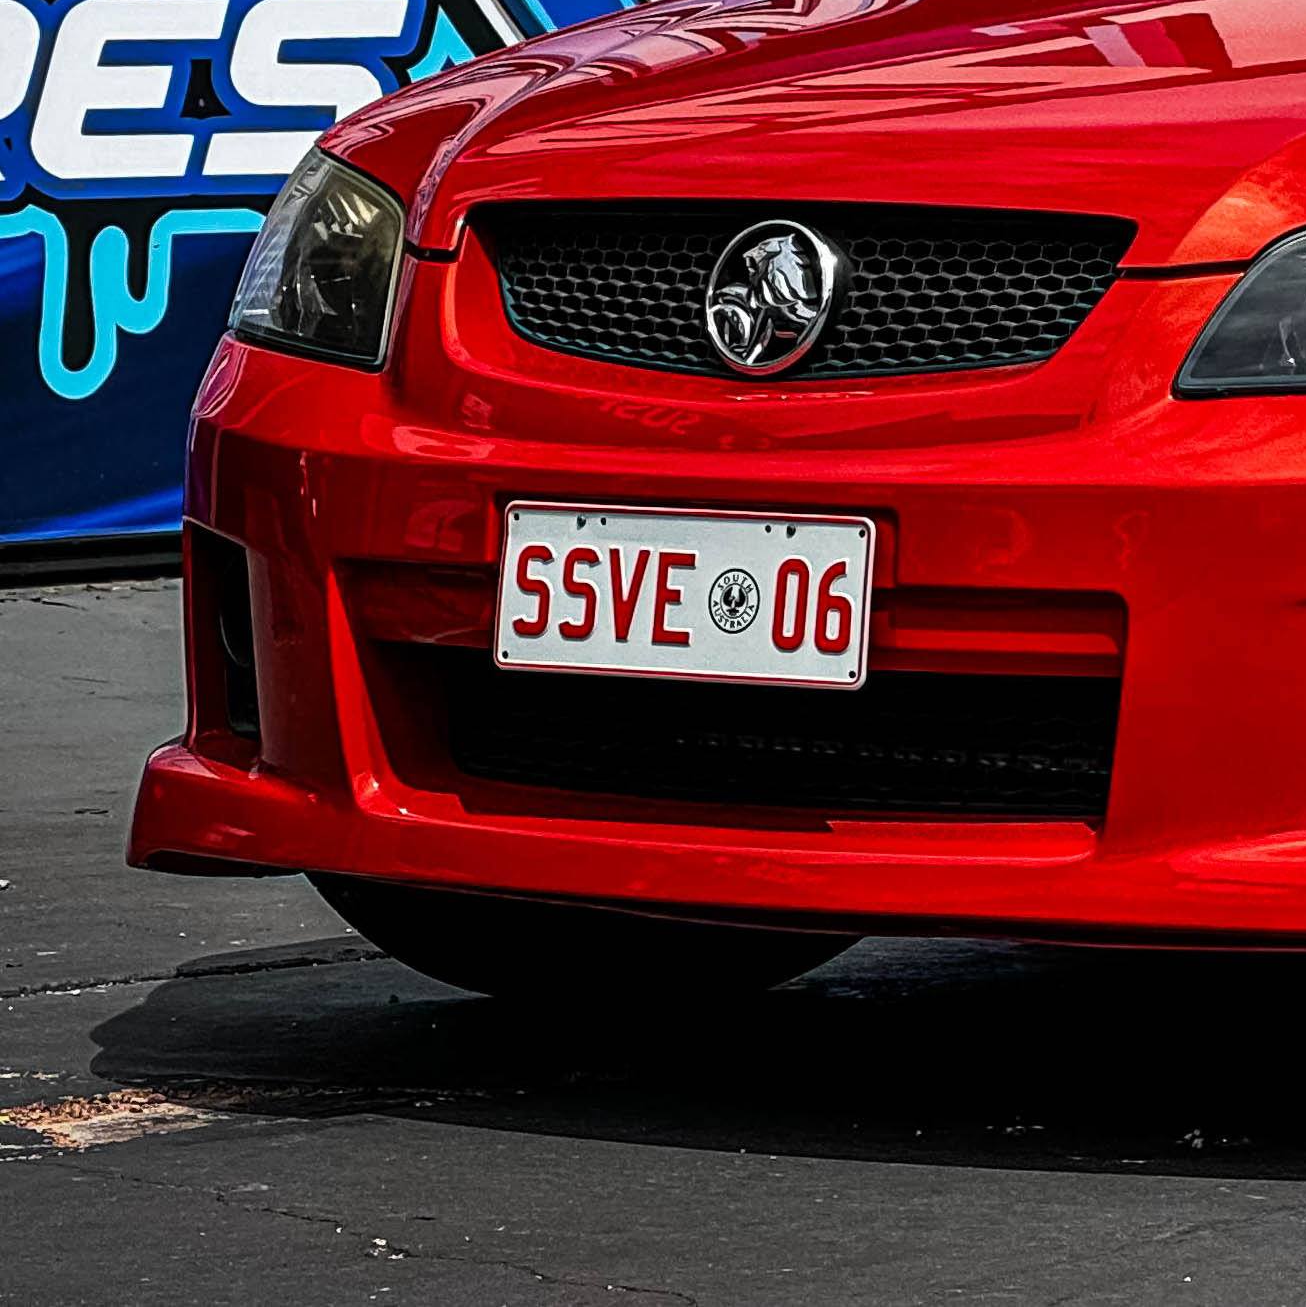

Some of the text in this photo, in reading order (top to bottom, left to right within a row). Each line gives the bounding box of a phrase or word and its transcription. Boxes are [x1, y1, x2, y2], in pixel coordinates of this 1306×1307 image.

[718, 574, 754, 594] SOUTH
[512, 544, 853, 655] SSVE 06
[713, 600, 755, 629] AUSTRALIA
